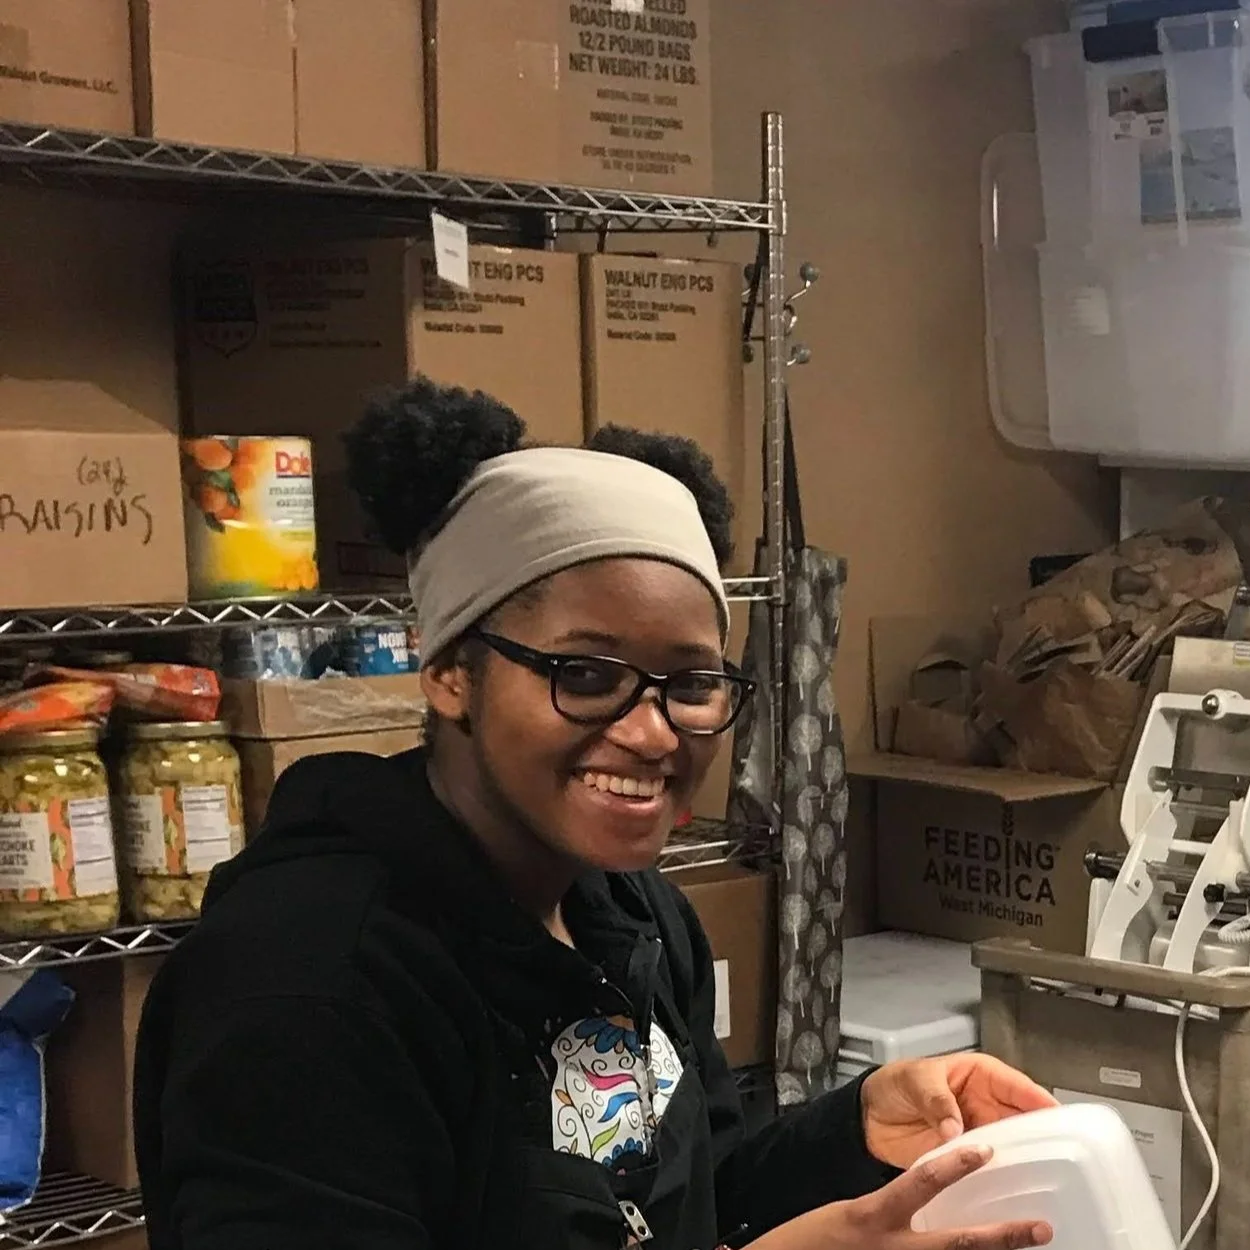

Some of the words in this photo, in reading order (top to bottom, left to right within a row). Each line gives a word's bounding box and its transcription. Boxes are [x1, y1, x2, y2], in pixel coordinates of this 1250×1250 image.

[569, 4, 631, 30] ROASTED
[634, 12, 697, 40] ALMONDS
[609, 35, 654, 57] POUND
[658, 40, 691, 62] BAGS
[569, 53, 594, 73] NET
[598, 56, 651, 80] WEIGHT:
[654, 63, 669, 81] 24
[484, 262, 513, 281] ENG
[516, 264, 544, 283] PCS
[604, 269, 658, 289] WALNUT
[661, 272, 687, 291] ENG
[689, 274, 714, 292] PCS
[0, 493, 153, 545] RAISINS
[924, 826, 1055, 872] FEEDING
[923, 858, 1056, 906] AMERICA
[938, 893, 974, 916] West
[978, 898, 1044, 928] Michigan
